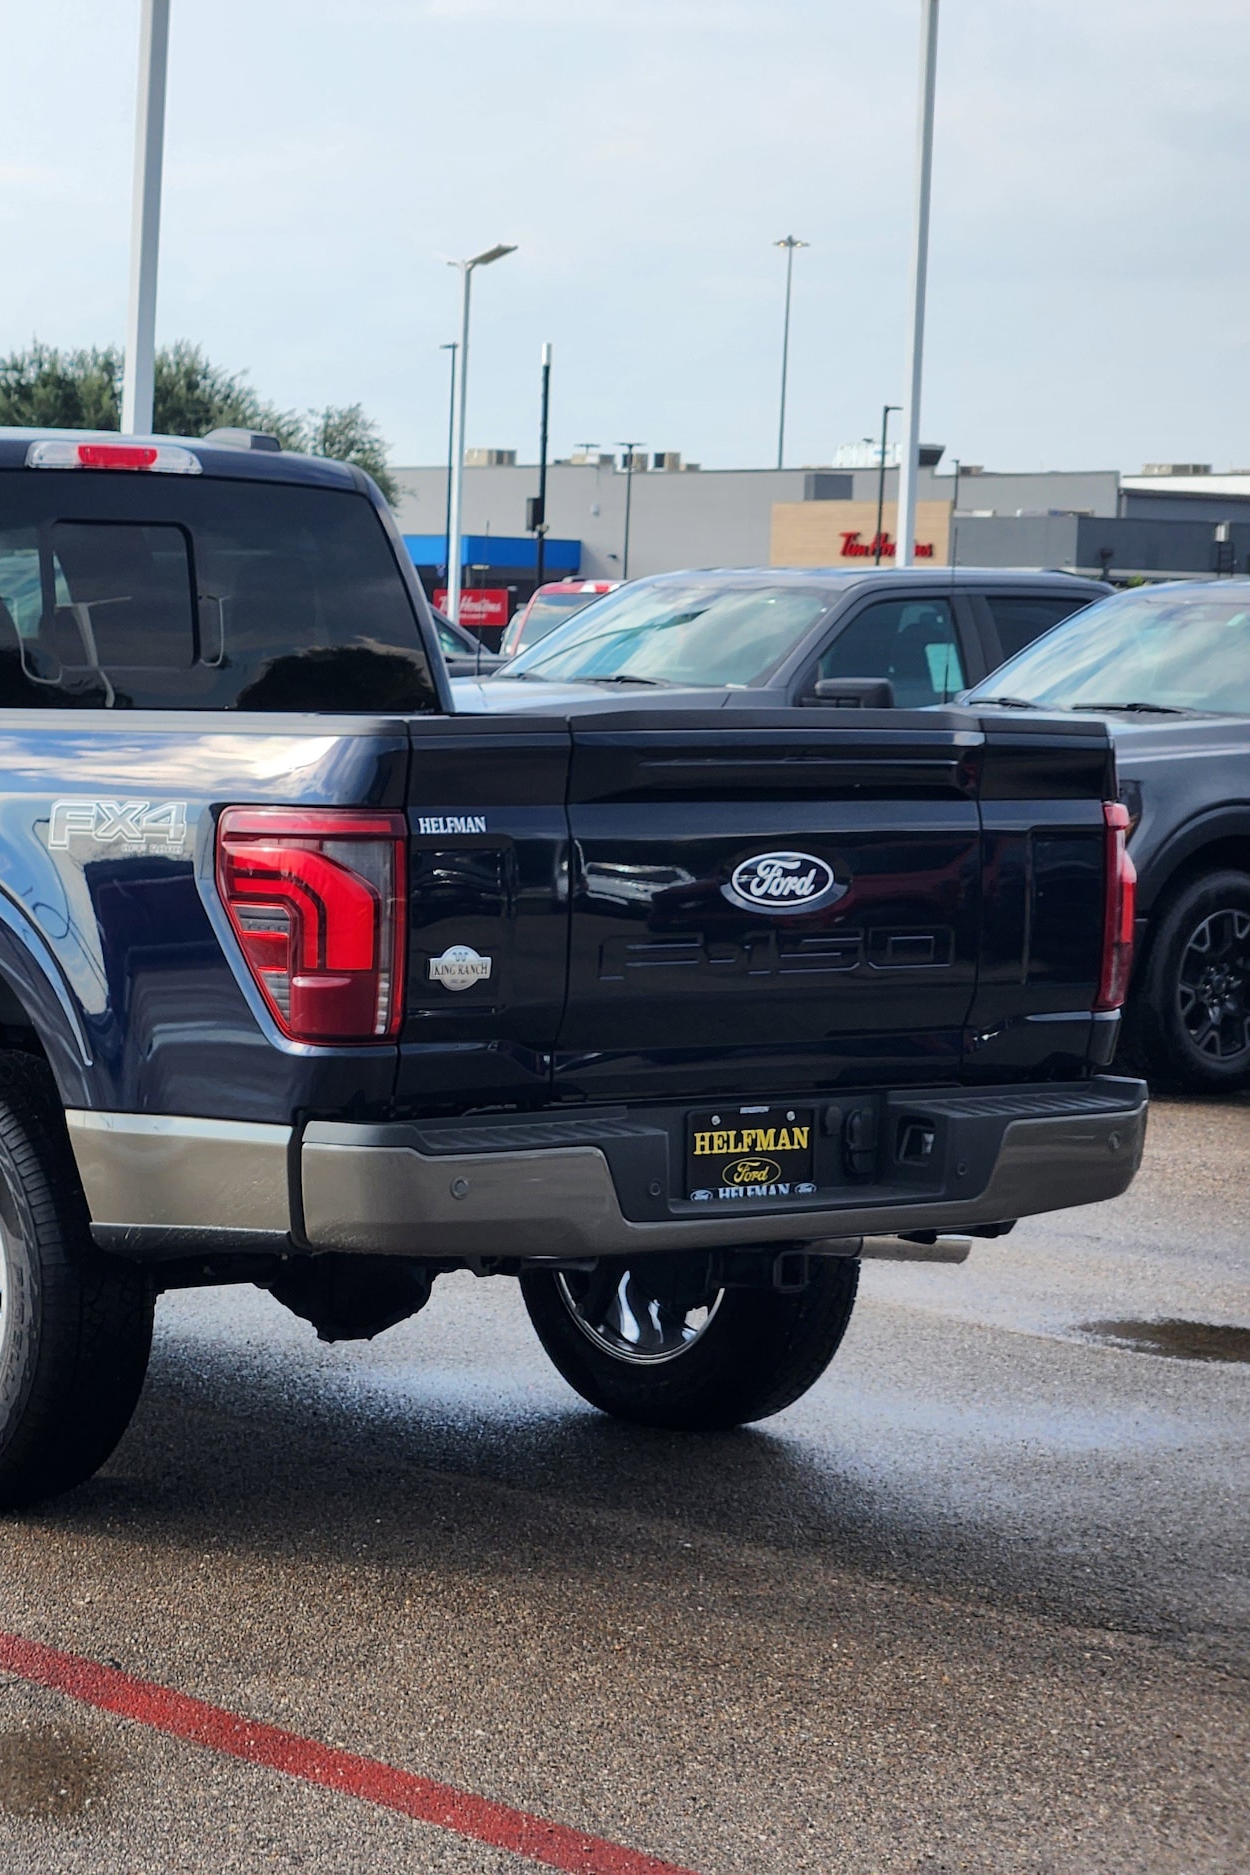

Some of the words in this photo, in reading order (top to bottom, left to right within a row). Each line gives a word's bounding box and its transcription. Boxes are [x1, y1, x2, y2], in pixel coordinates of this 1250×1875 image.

[839, 531, 869, 557] Tim
[48, 799, 187, 850] FX4
[418, 816, 487, 834] HELFMAN
[750, 858, 817, 898] Ford
[434, 963, 456, 976] KING
[458, 962, 488, 975] RANCH
[693, 1127, 810, 1155] HELFMAN
[733, 1161, 770, 1183] Ford
